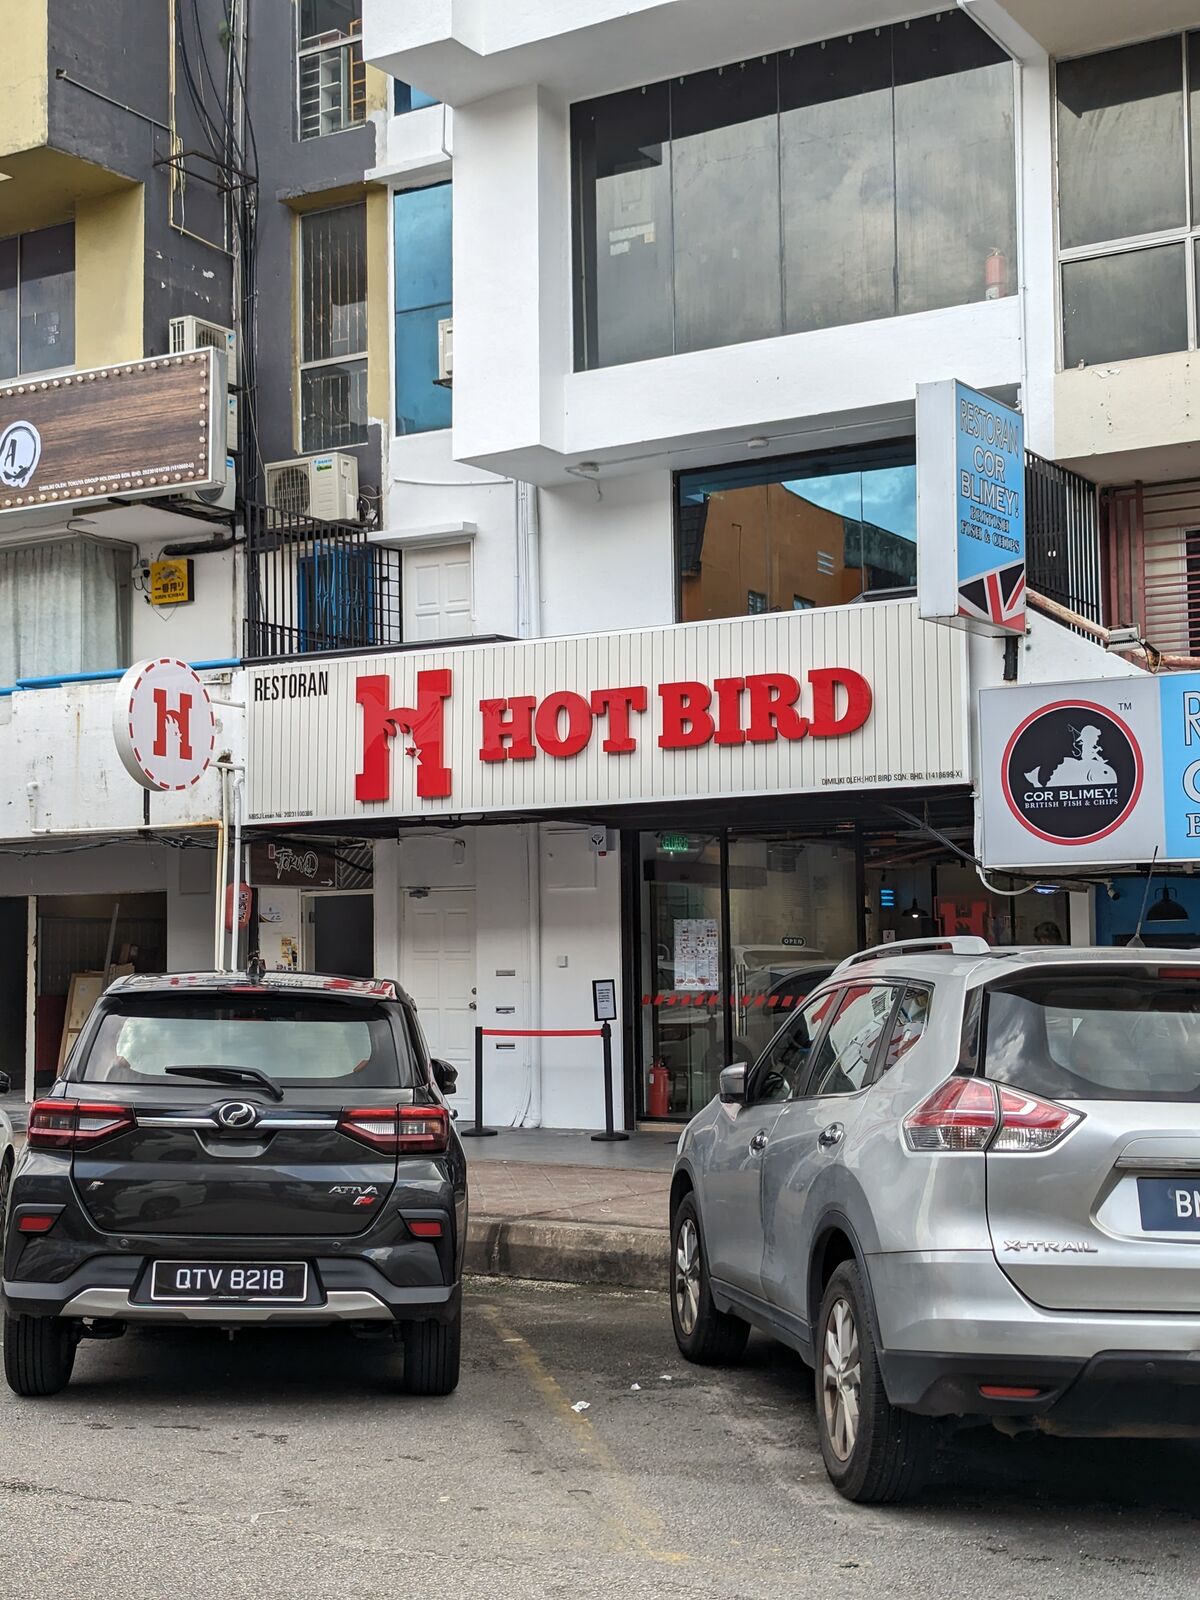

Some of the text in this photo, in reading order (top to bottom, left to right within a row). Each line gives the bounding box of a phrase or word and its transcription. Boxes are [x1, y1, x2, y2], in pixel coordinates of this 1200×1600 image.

[960, 398, 1019, 459] RESTORAN
[973, 445, 1006, 483] COR
[960, 468, 1019, 519] BLIMEY!
[970, 505, 1009, 533] BRITISH
[960, 519, 1020, 554] FISH & CHIPS
[254, 671, 329, 702] RESTORAN
[152, 688, 193, 760] H
[479, 667, 873, 762] HOT BIRD
[355, 668, 453, 803] H
[878, 774, 892, 782] BIRD
[1023, 787, 1118, 802] COR BLIMEY!
[1025, 801, 1059, 809] BRITISH
[1093, 798, 1118, 806] CHIPS
[1003, 1239, 1099, 1254] X-TRAIL
[175, 1268, 284, 1290] QTV 8218
